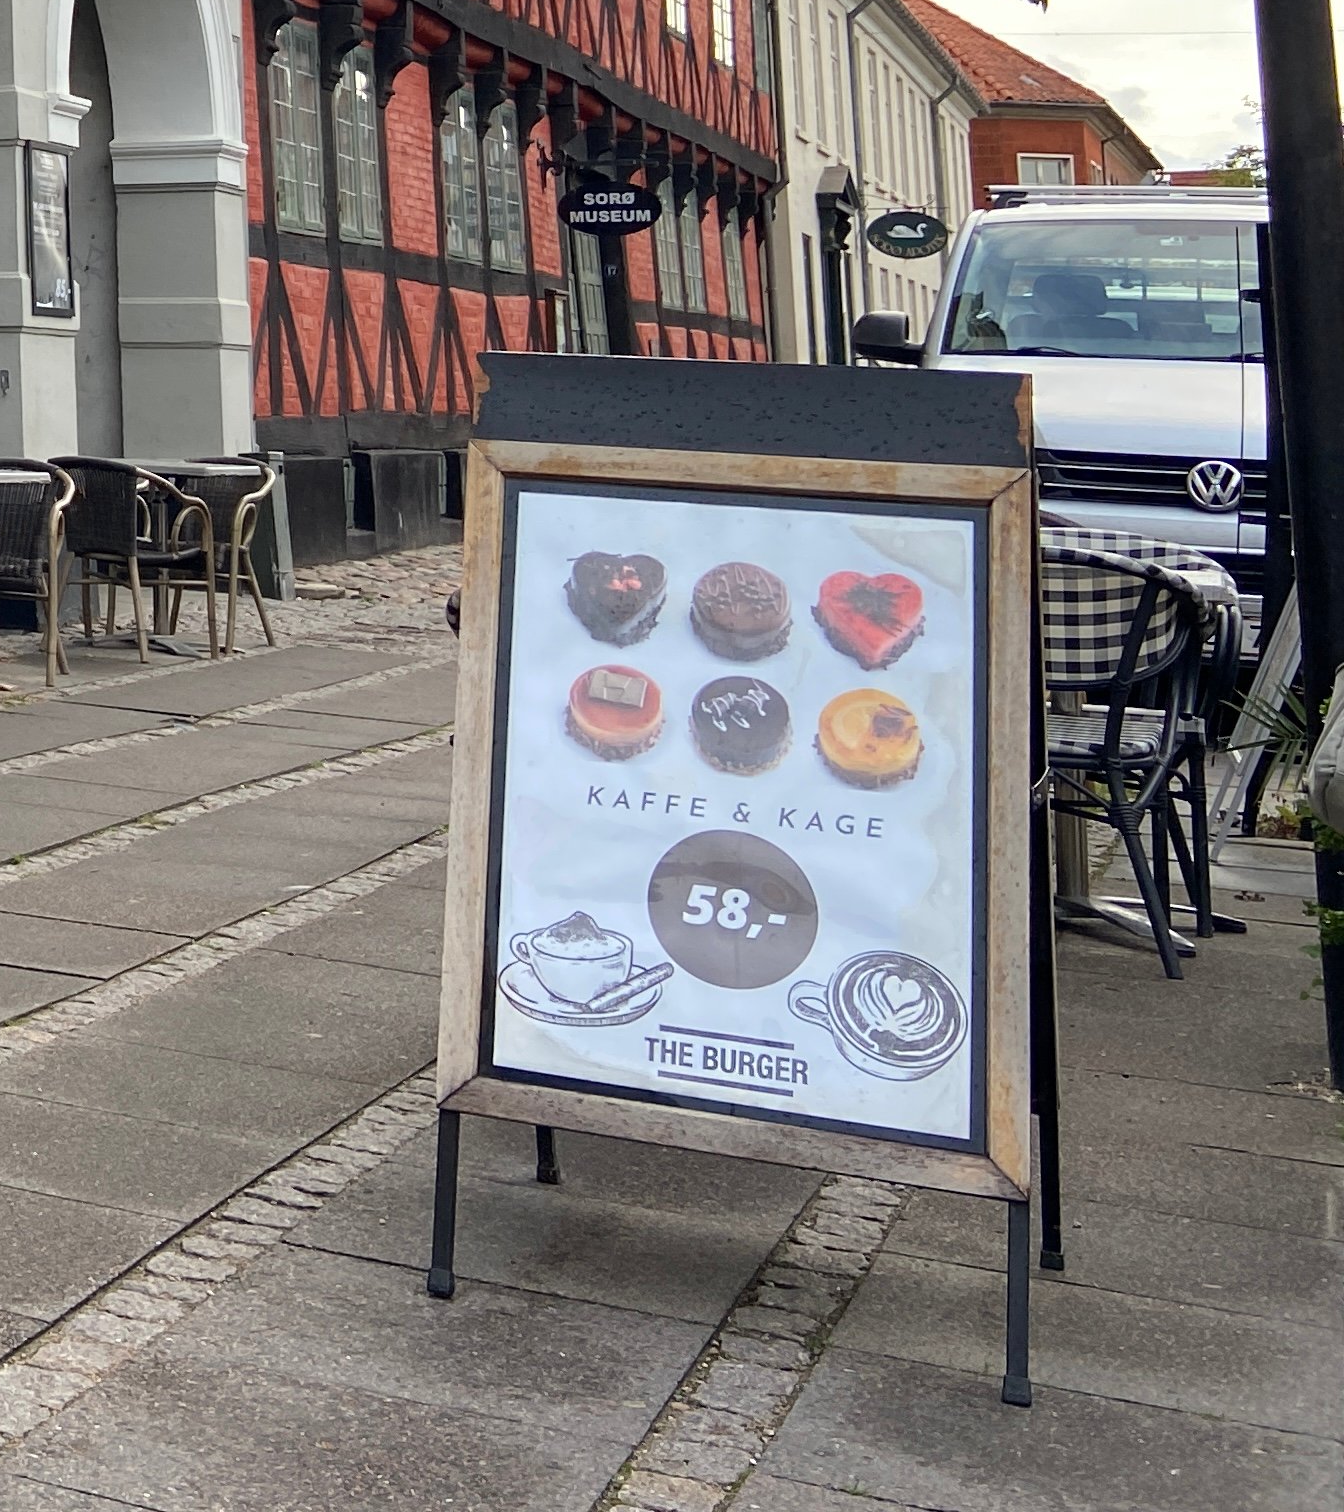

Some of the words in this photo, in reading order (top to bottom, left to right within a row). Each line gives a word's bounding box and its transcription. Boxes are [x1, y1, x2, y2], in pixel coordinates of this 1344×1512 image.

[569, 209, 652, 224] MUSEUM
[583, 192, 635, 205] SORØ
[587, 785, 708, 818] KAFFE
[732, 802, 751, 823] &
[778, 807, 885, 839] KAGE
[682, 884, 787, 939] 58,-
[644, 1036, 693, 1068] THE
[702, 1045, 809, 1086] BURGER
